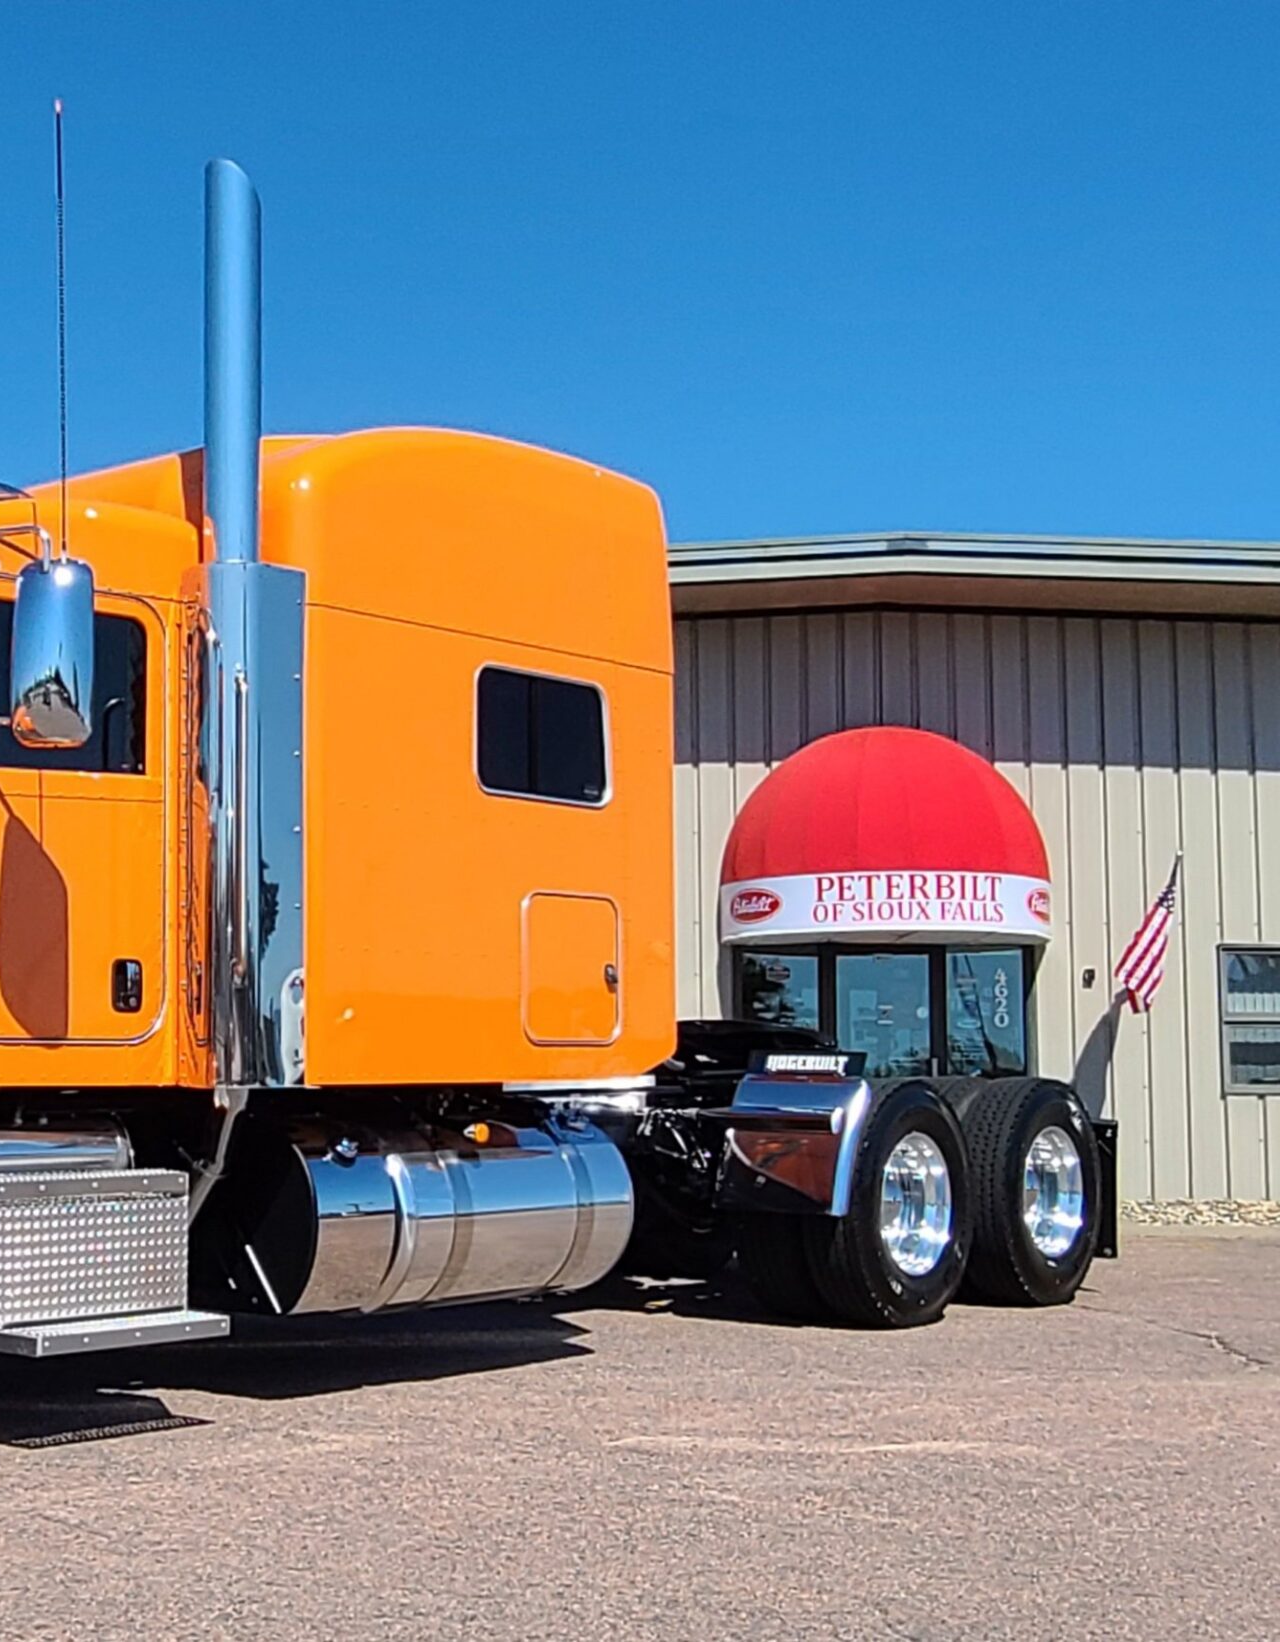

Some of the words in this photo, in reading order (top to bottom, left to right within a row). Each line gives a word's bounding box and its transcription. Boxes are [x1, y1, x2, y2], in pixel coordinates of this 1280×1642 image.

[815, 873, 1002, 903] PETERBILT
[812, 902, 845, 923] OF
[851, 900, 930, 922] SIOUX
[940, 900, 1004, 923] FALLS
[993, 967, 1010, 1028] 4620
